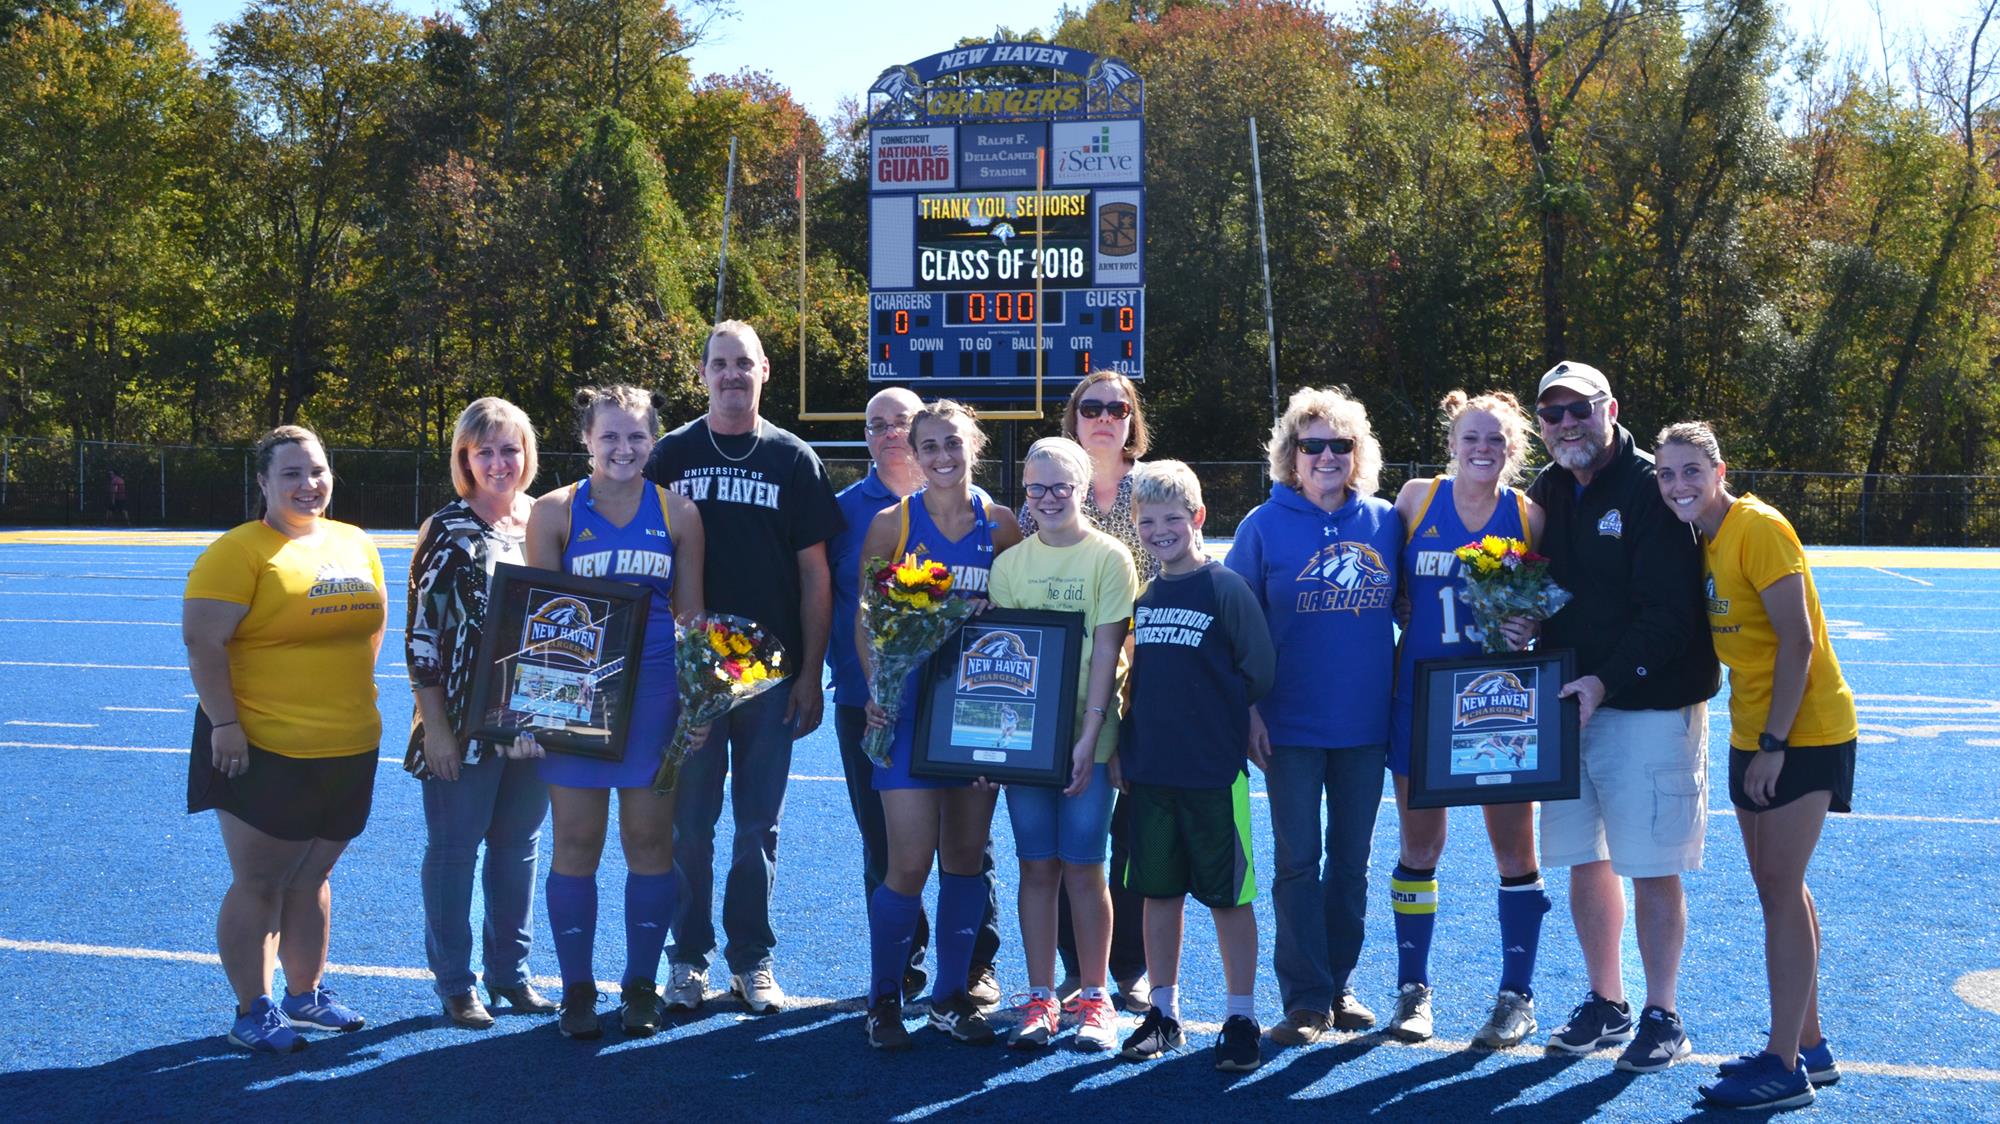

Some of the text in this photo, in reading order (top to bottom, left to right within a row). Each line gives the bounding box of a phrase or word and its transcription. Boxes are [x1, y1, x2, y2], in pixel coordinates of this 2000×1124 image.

[937, 46, 1069, 71] NEW HAVEN
[927, 88, 1080, 115] CHARGERS
[880, 134, 930, 145] CONNECTICUT
[1016, 134, 1029, 145] F.
[878, 145, 933, 158] NATIONAL
[1059, 150, 1132, 172] iServe
[878, 157, 949, 183] GUARD
[922, 198, 970, 220] THANK
[921, 247, 1084, 281] CLASS OF 2018
[1098, 262, 1138, 271] ARMY ROTC
[874, 294, 932, 310] CHARGERS
[1085, 291, 1137, 307] GUEST
[895, 310, 909, 334] 0
[1119, 307, 1134, 331] 0
[910, 338, 943, 351] DOWN
[959, 337, 992, 351] TO GO
[1012, 337, 1037, 350] BALL
[1070, 336, 1093, 350] QTR
[870, 363, 898, 376] T.O.L.
[684, 467, 763, 479] UNIVERSITY OF
[717, 476, 780, 510] HAVEN
[572, 550, 671, 579] NEW HAVEN
[1416, 551, 1456, 577] NEW
[1063, 584, 1085, 600] did.
[1296, 587, 1393, 613] LACROSSE
[311, 604, 348, 616] FIELD
[1149, 608, 1214, 630] BRANCHBURG
[531, 622, 596, 650] NEW HAVEN
[1135, 627, 1203, 648] WRESTLING
[967, 658, 1031, 679] NEW HAVEN
[973, 673, 1024, 687] CHARGERS
[1462, 693, 1529, 713] NEW HAVEN
[1469, 707, 1521, 718] CHARGERS
